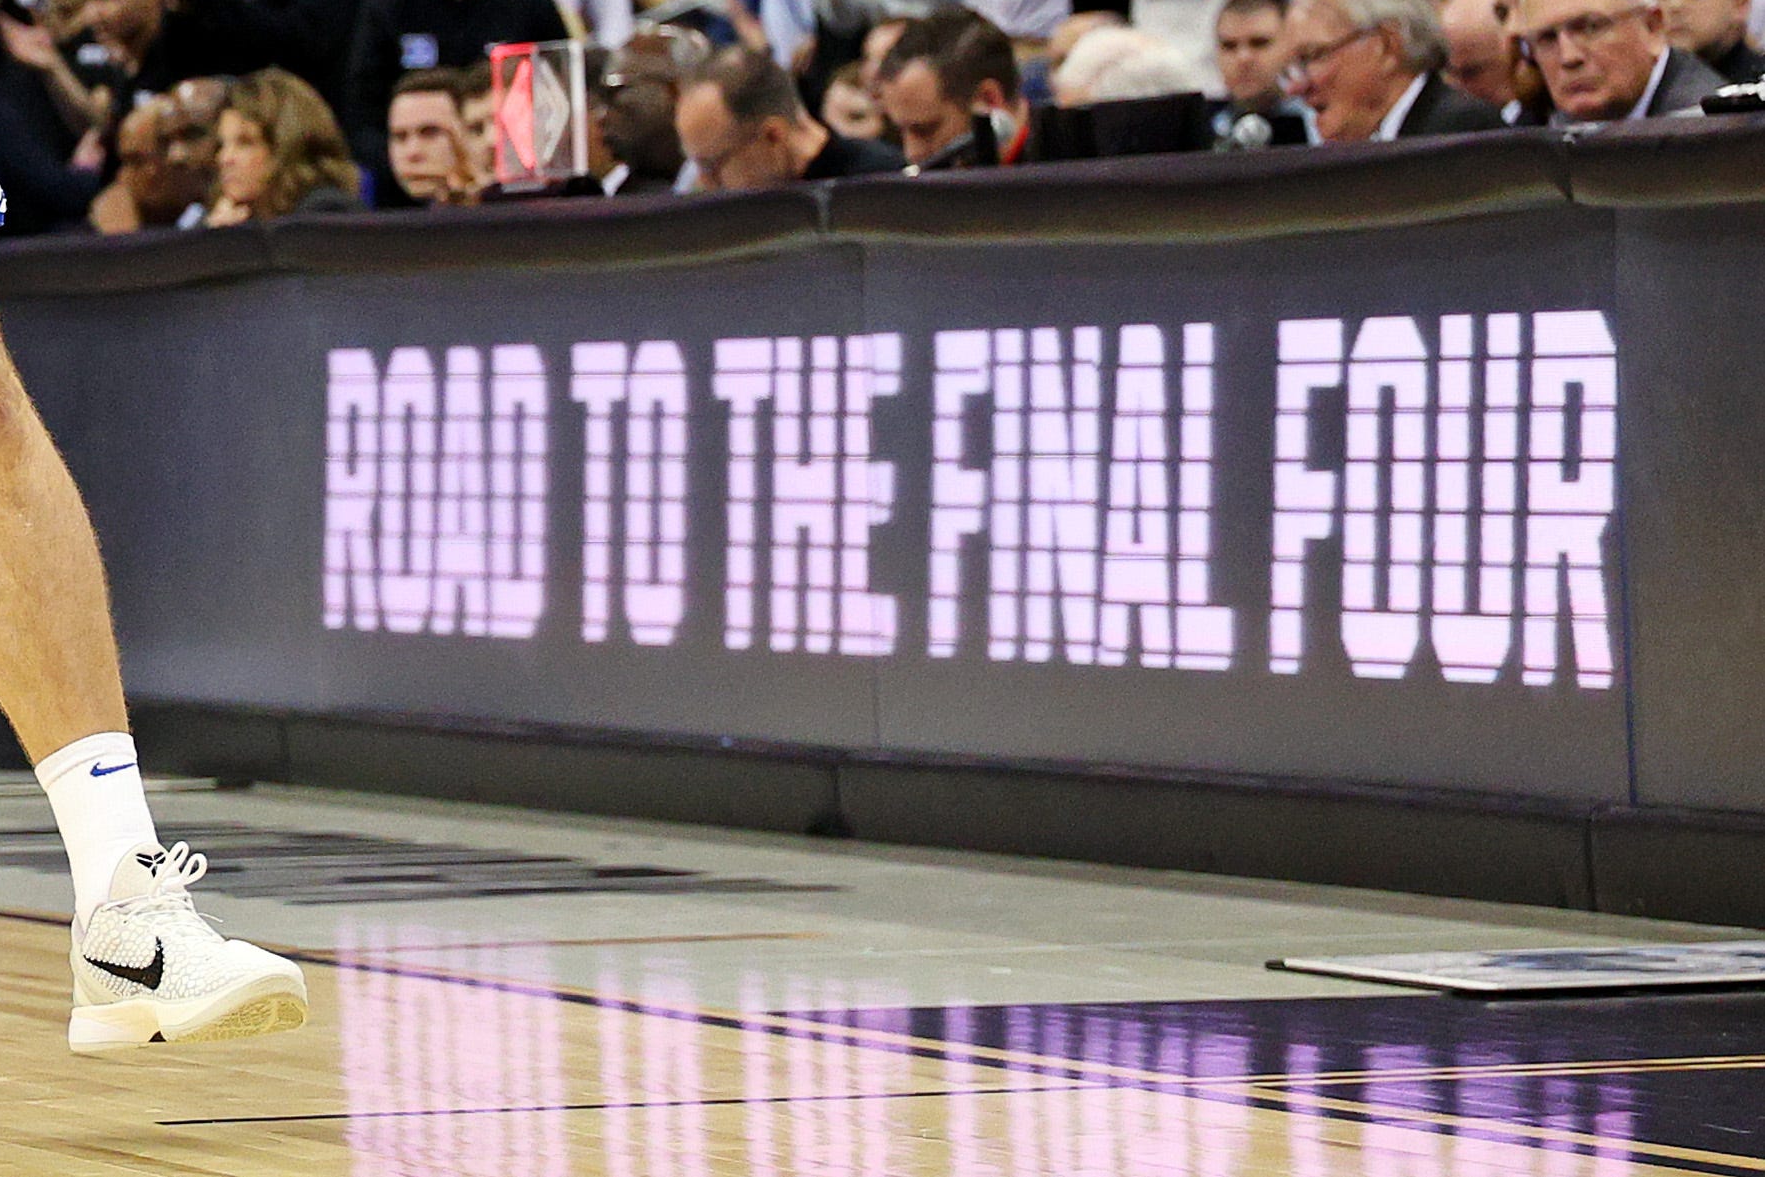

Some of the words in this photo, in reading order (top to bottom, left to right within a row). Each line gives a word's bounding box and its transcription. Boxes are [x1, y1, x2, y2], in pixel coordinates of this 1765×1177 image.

[323, 347, 548, 639] ROAD
[570, 340, 688, 646] TO
[711, 332, 903, 657] THE
[927, 322, 1234, 671] FINAL
[1269, 310, 1618, 690] FOUR
